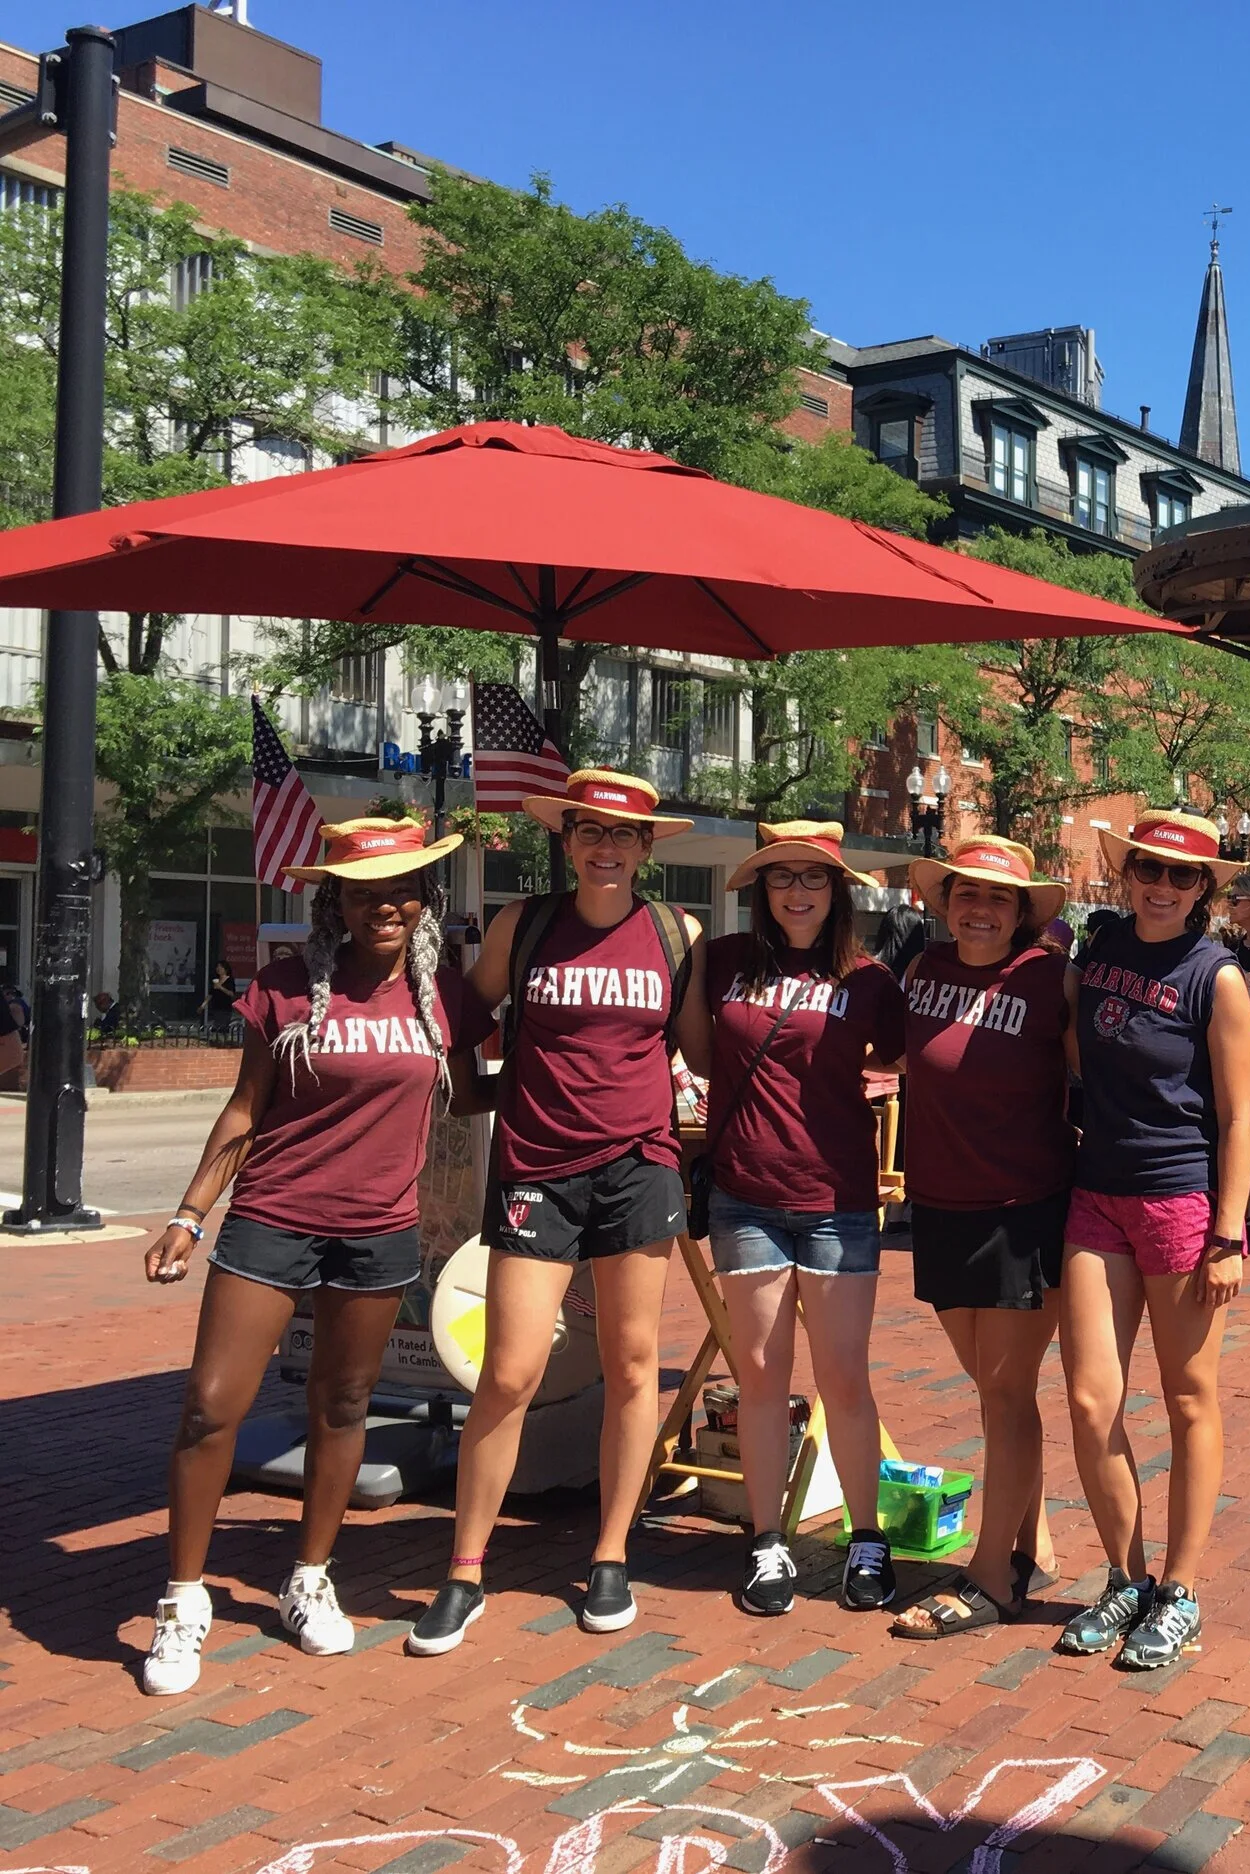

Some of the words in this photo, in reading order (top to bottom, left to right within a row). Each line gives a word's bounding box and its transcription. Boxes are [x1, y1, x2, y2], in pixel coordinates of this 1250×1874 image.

[593, 790, 628, 803] HARVARD
[1153, 829, 1185, 844] HARVARD
[361, 839, 396, 850] HARVARD
[979, 853, 1011, 868] HARVARD
[518, 1229, 537, 1238] POLO
[398, 1338, 427, 1351] Rated
[398, 1353, 408, 1364] In
